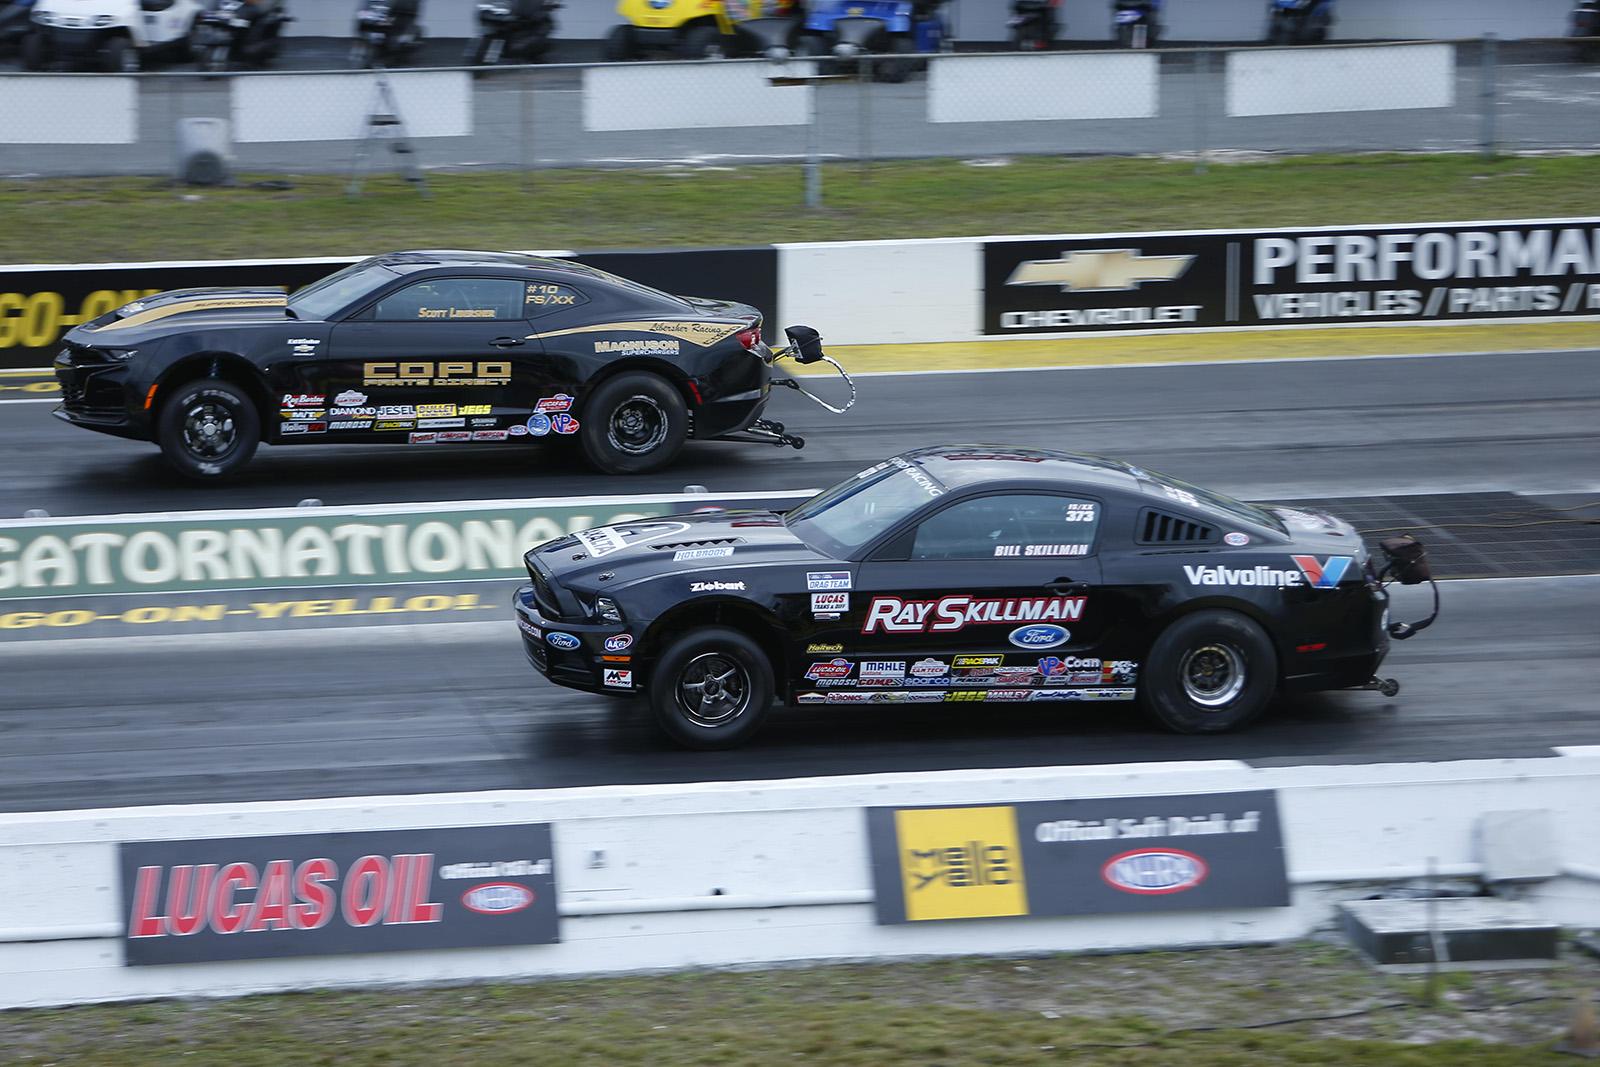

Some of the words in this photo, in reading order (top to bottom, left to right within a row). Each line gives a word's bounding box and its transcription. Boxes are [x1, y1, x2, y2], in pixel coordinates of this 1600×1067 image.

[1253, 228, 1600, 284] PERFORMA
[527, 284, 559, 294] #10
[525, 294, 575, 305] FS/XX
[1001, 305, 1203, 328] CHEVROLET
[594, 340, 680, 353] MAGNUSON
[363, 361, 512, 379] COPO
[329, 407, 376, 416] DIAMOND
[378, 406, 415, 415] JESEL
[462, 405, 492, 414] JEGS
[1065, 511, 1095, 522] 373
[994, 546, 1021, 556] BILL
[1024, 544, 1090, 556] SKILLMAN
[1183, 565, 1304, 587] Valvoline
[815, 594, 845, 603] LUCAS
[931, 597, 1085, 631] SKILLMAN
[552, 634, 573, 647] Ford
[1023, 629, 1055, 643] Ford
[866, 663, 905, 671] MAHLE
[1064, 656, 1100, 668] Coan
[130, 859, 338, 938] LUCAS
[341, 854, 444, 927] OIL
